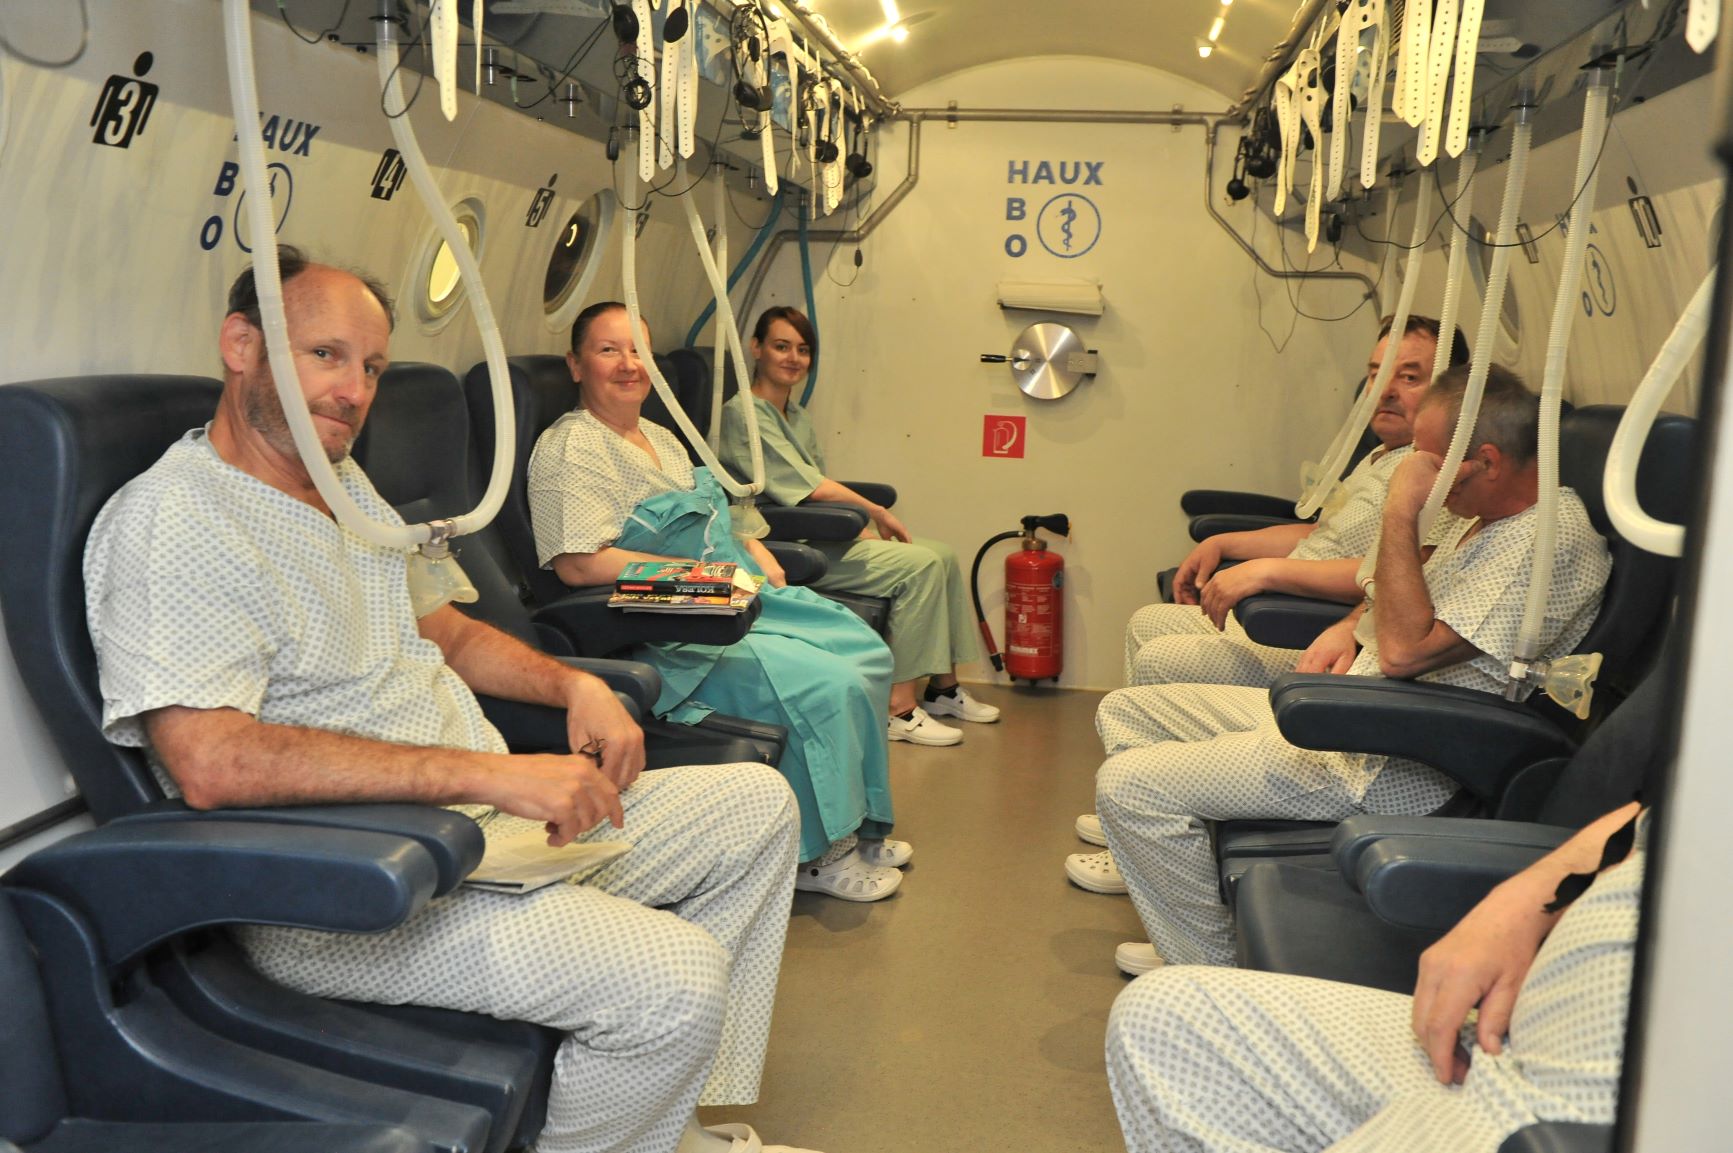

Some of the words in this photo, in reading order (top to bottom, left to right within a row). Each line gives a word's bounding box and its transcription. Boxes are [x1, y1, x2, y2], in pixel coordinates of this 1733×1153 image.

[103, 81, 141, 146] 3
[233, 111, 320, 157] AUX
[213, 161, 239, 197] B
[380, 153, 401, 198] 4
[1007, 160, 1104, 186] HAUX
[529, 190, 550, 226] 5
[1005, 197, 1027, 221] B
[200, 215, 223, 251] O
[1004, 233, 1028, 258] O
